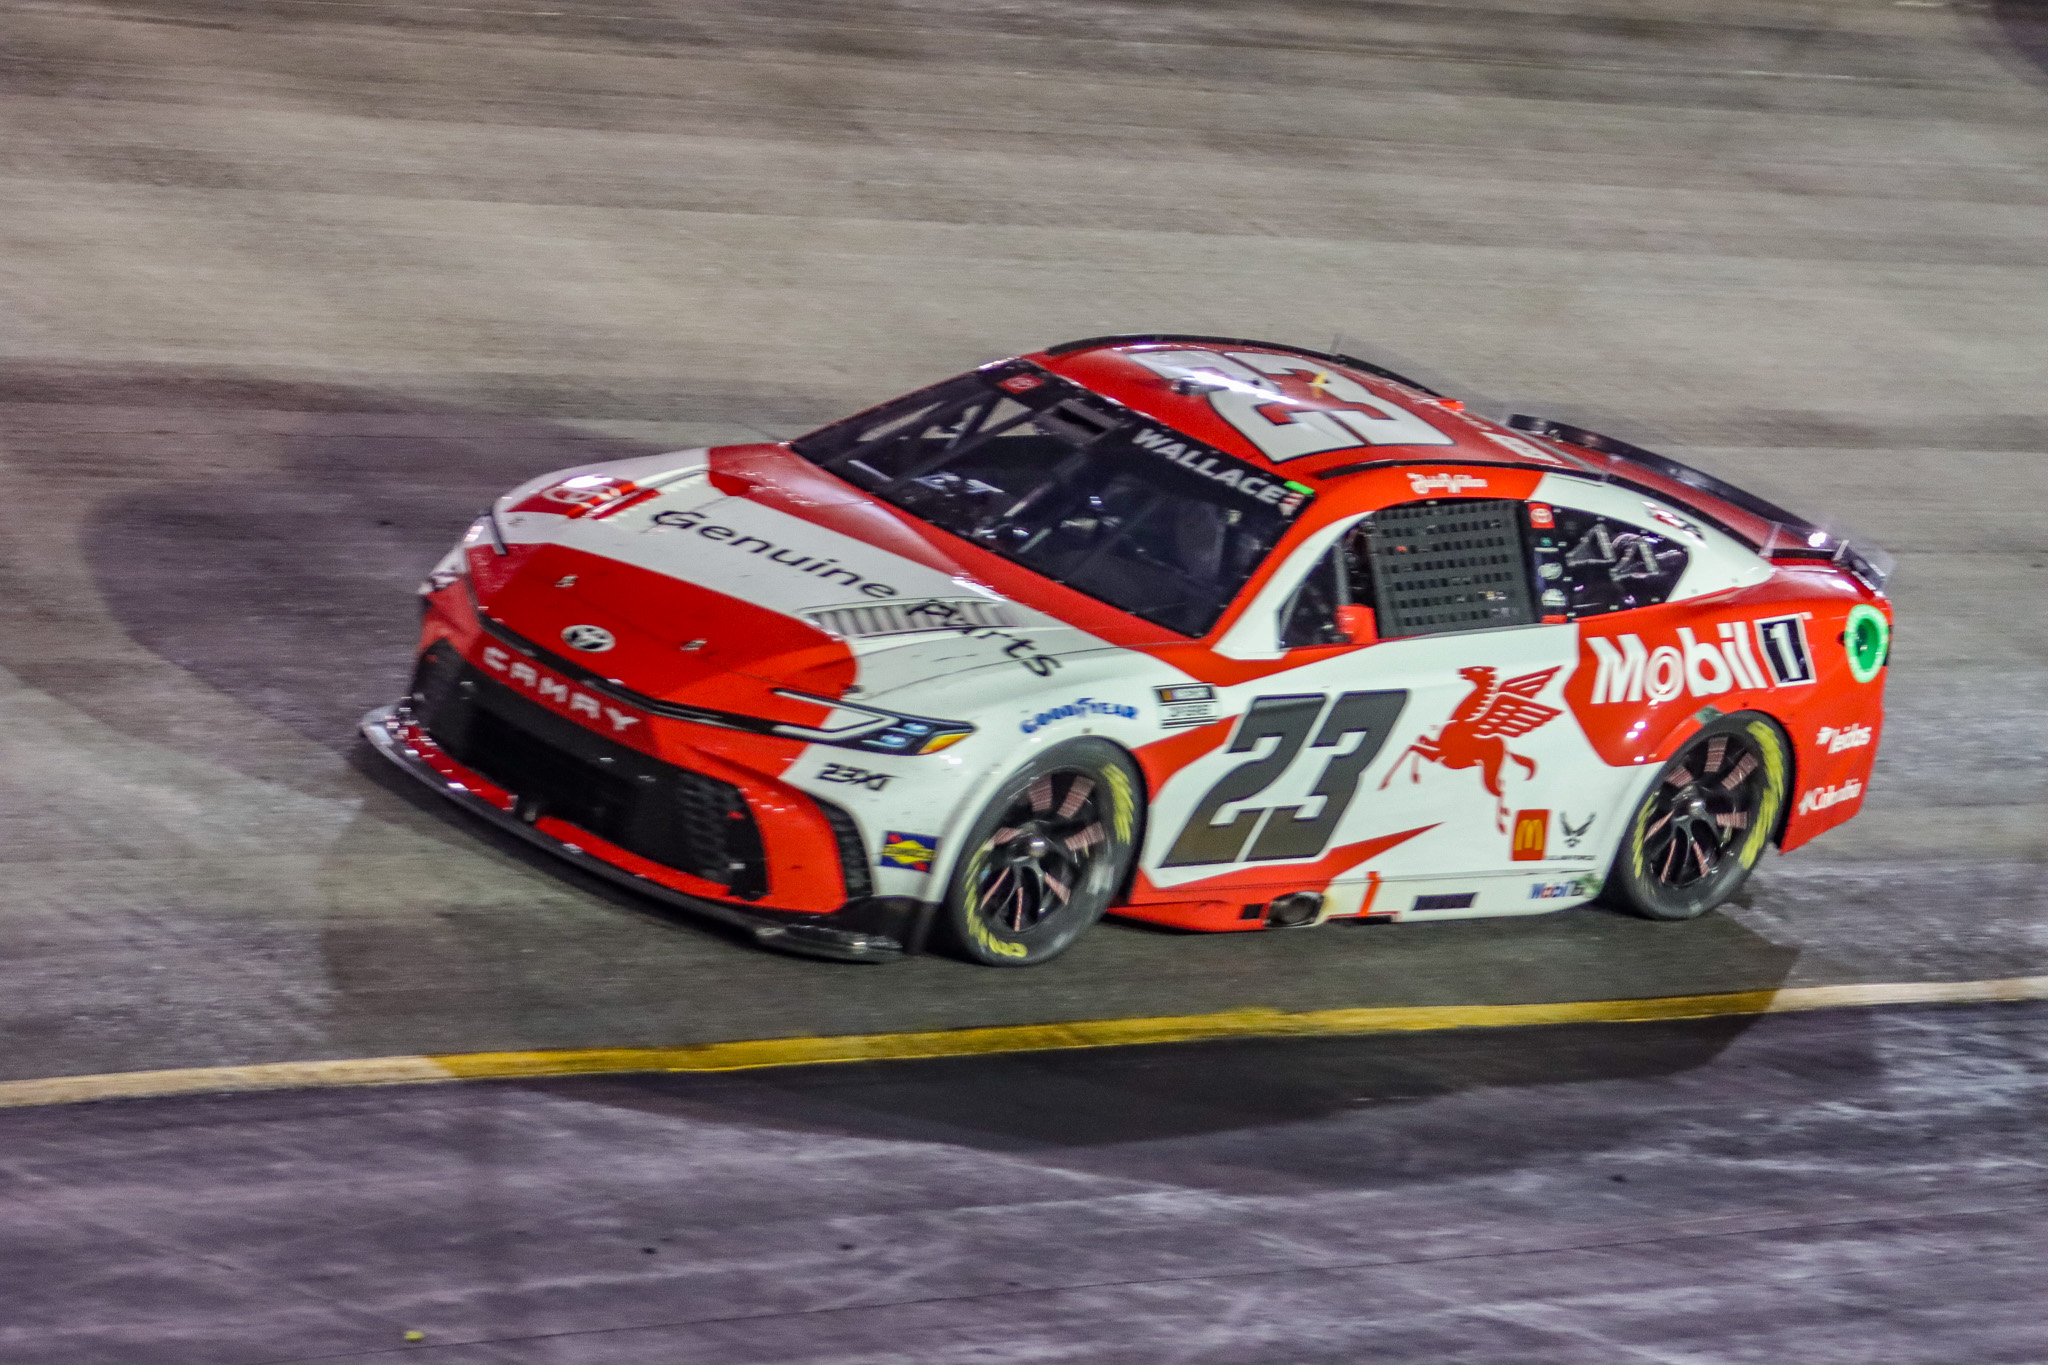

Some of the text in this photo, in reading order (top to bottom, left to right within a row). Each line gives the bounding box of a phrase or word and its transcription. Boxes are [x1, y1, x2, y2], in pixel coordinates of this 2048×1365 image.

[1127, 350, 1457, 464] 23
[1131, 428, 1290, 504] WALLACE
[652, 510, 899, 599] Genuine
[483, 646, 641, 731] CAMRY
[1585, 616, 1811, 704] Mobil 1
[1153, 688, 1412, 869] 23
